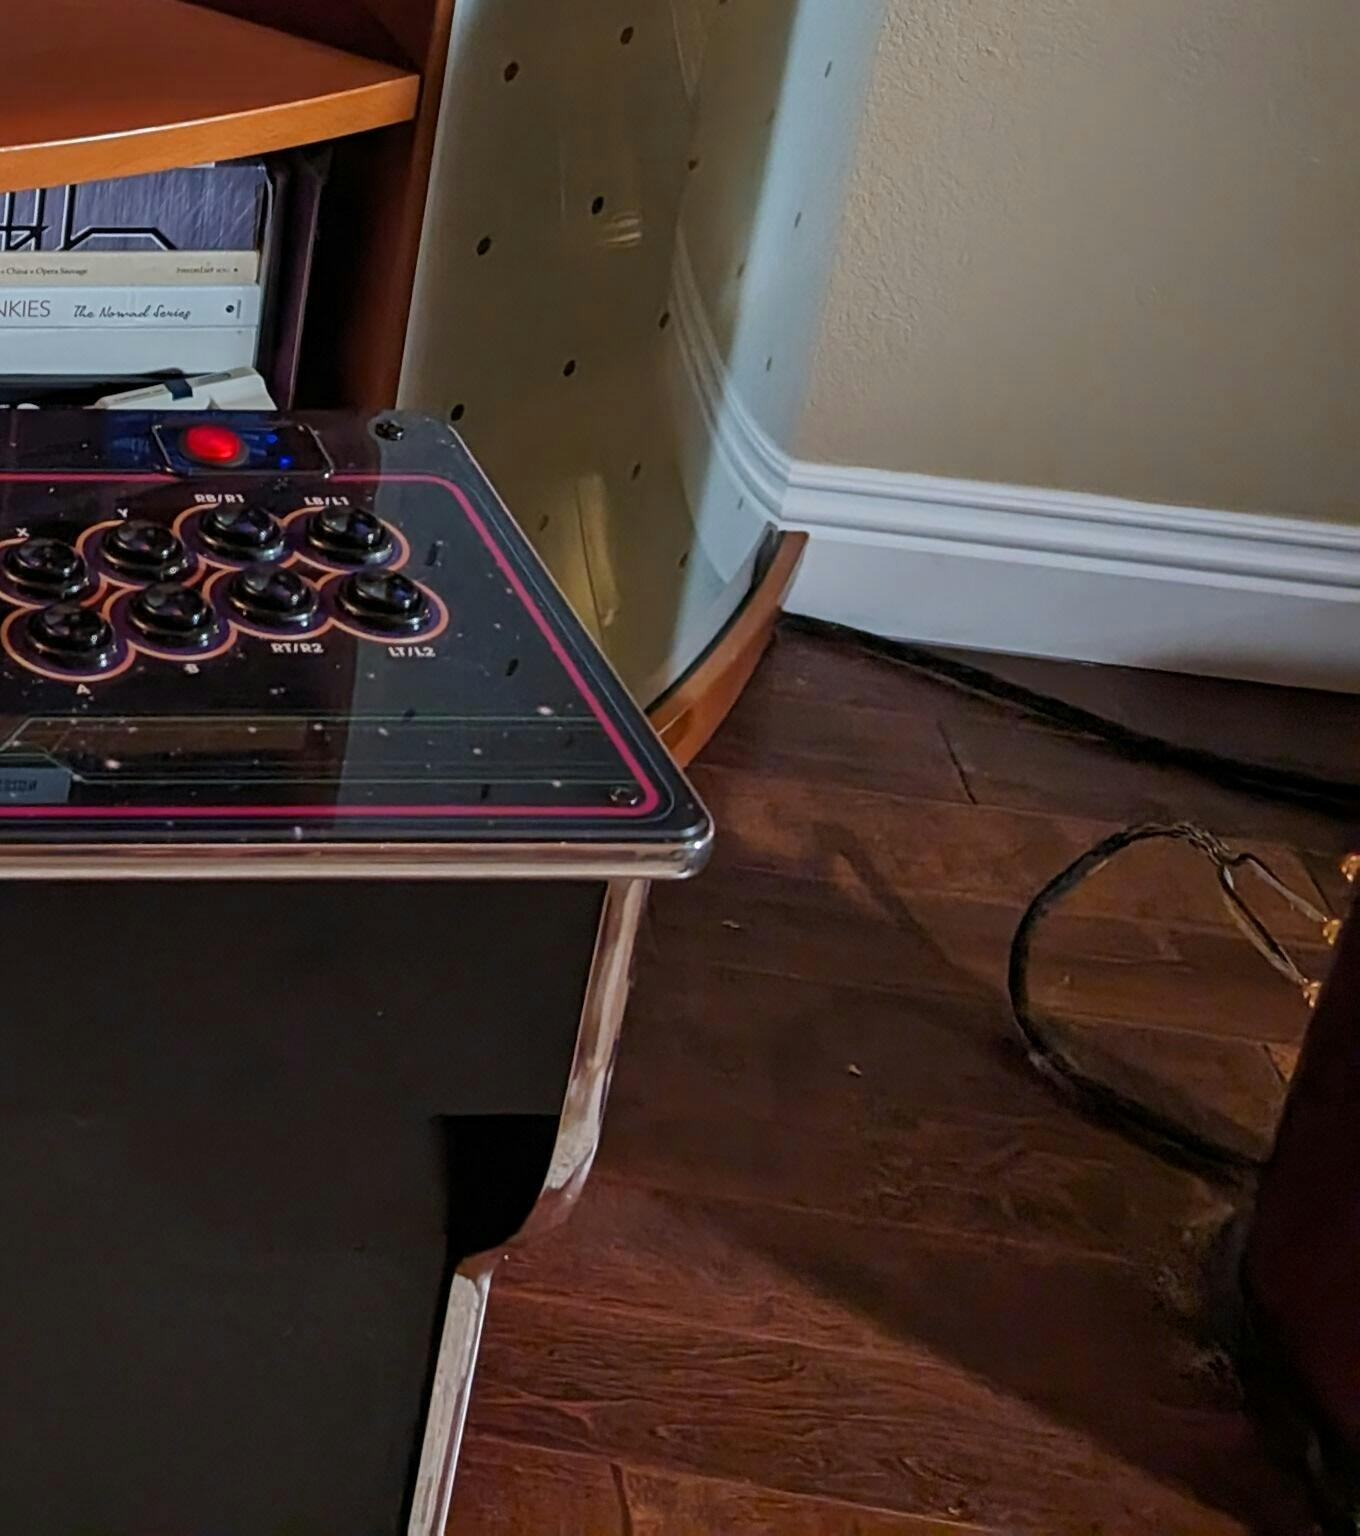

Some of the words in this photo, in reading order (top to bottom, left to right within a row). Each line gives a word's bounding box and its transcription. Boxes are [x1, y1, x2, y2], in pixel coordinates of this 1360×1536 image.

[74, 305, 94, 318] The
[98, 304, 151, 318] Nomad
[153, 304, 191, 320] Series
[194, 493, 245, 504] RB/R1
[304, 496, 350, 506] LB/L1
[271, 642, 324, 654] RT/R2
[389, 646, 436, 658] LT/L2
[77, 684, 91, 695] A
